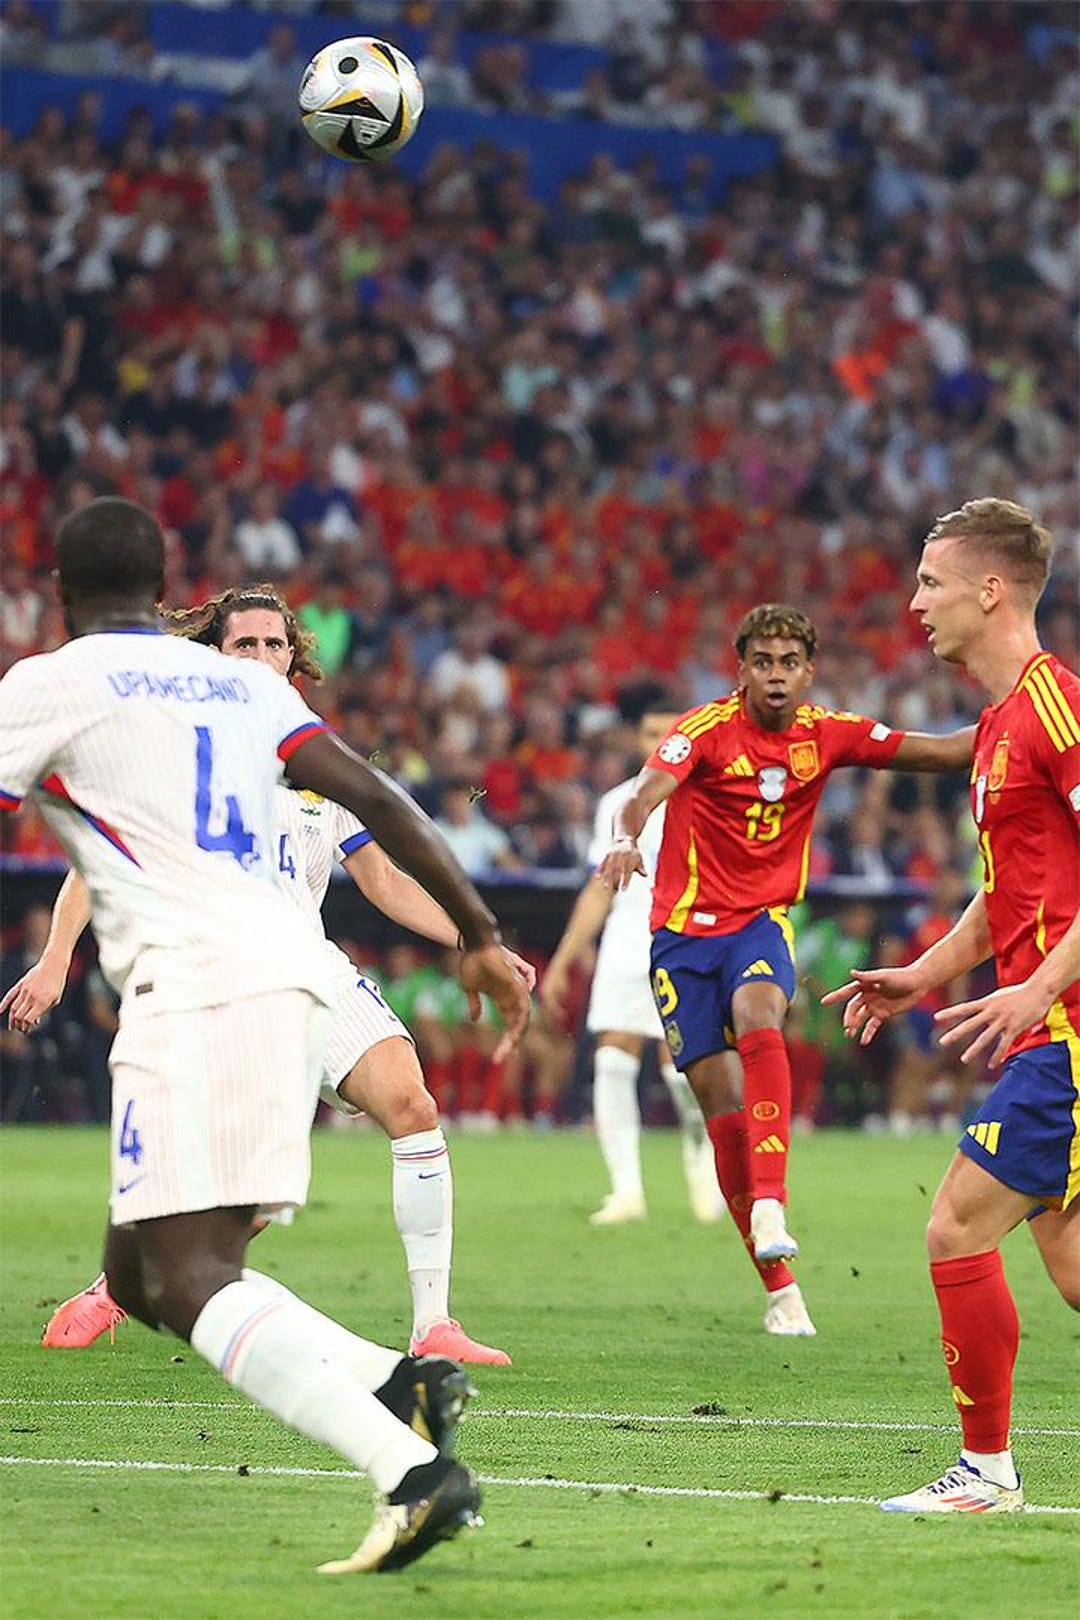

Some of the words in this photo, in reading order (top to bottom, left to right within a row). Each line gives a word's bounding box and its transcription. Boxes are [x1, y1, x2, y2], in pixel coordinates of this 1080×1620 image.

[194, 725, 260, 872] 4
[745, 801, 786, 841] 19
[119, 1098, 143, 1166] 4
